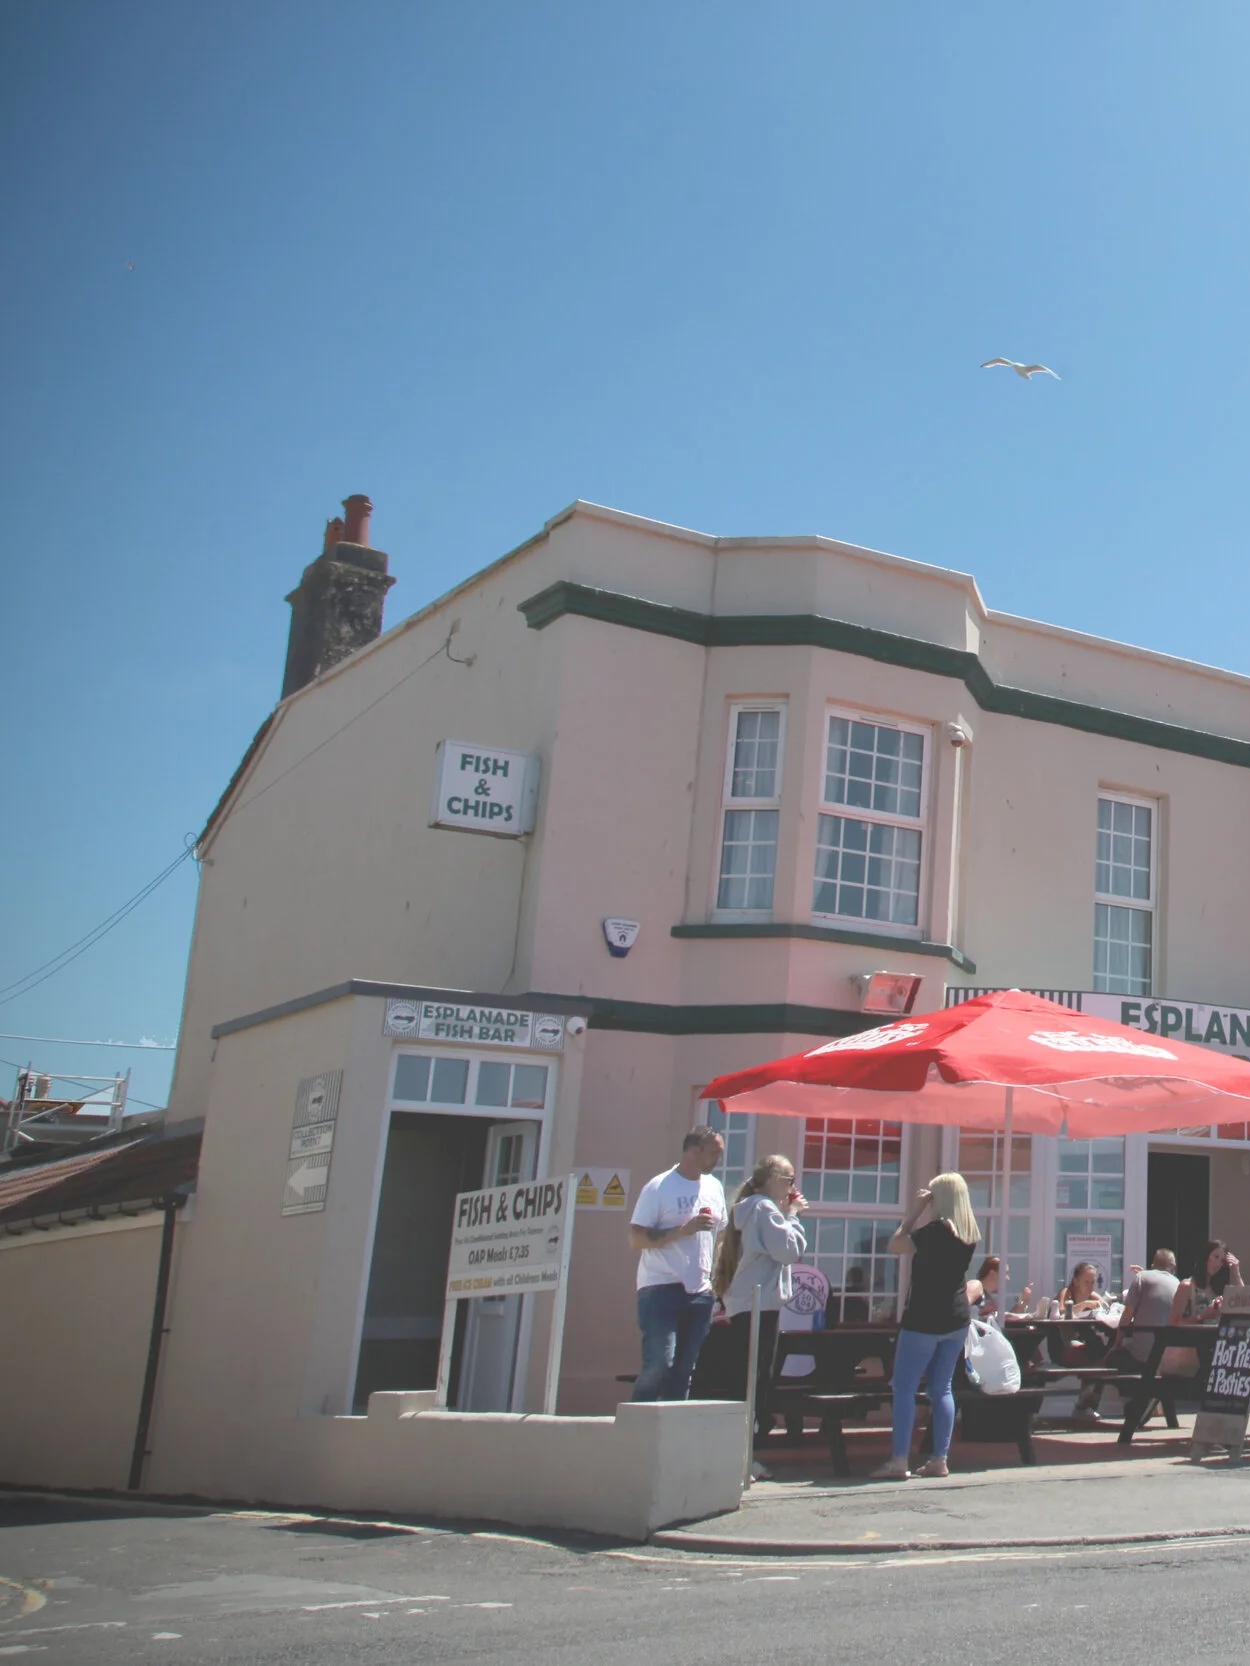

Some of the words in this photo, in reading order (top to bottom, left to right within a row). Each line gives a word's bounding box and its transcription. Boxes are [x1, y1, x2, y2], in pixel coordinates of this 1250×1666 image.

[460, 753, 509, 778] FISH
[474, 778, 491, 797] &
[446, 796, 514, 822] CHIPS
[423, 1005, 530, 1028] ESPLANADE
[434, 1023, 474, 1040] FISH
[478, 1028, 516, 1043] BAR
[457, 1193, 493, 1228] FISH
[496, 1192, 508, 1223] &
[513, 1181, 563, 1220] CHIPS
[468, 1248, 486, 1265] OAP
[486, 1245, 507, 1262] Meals
